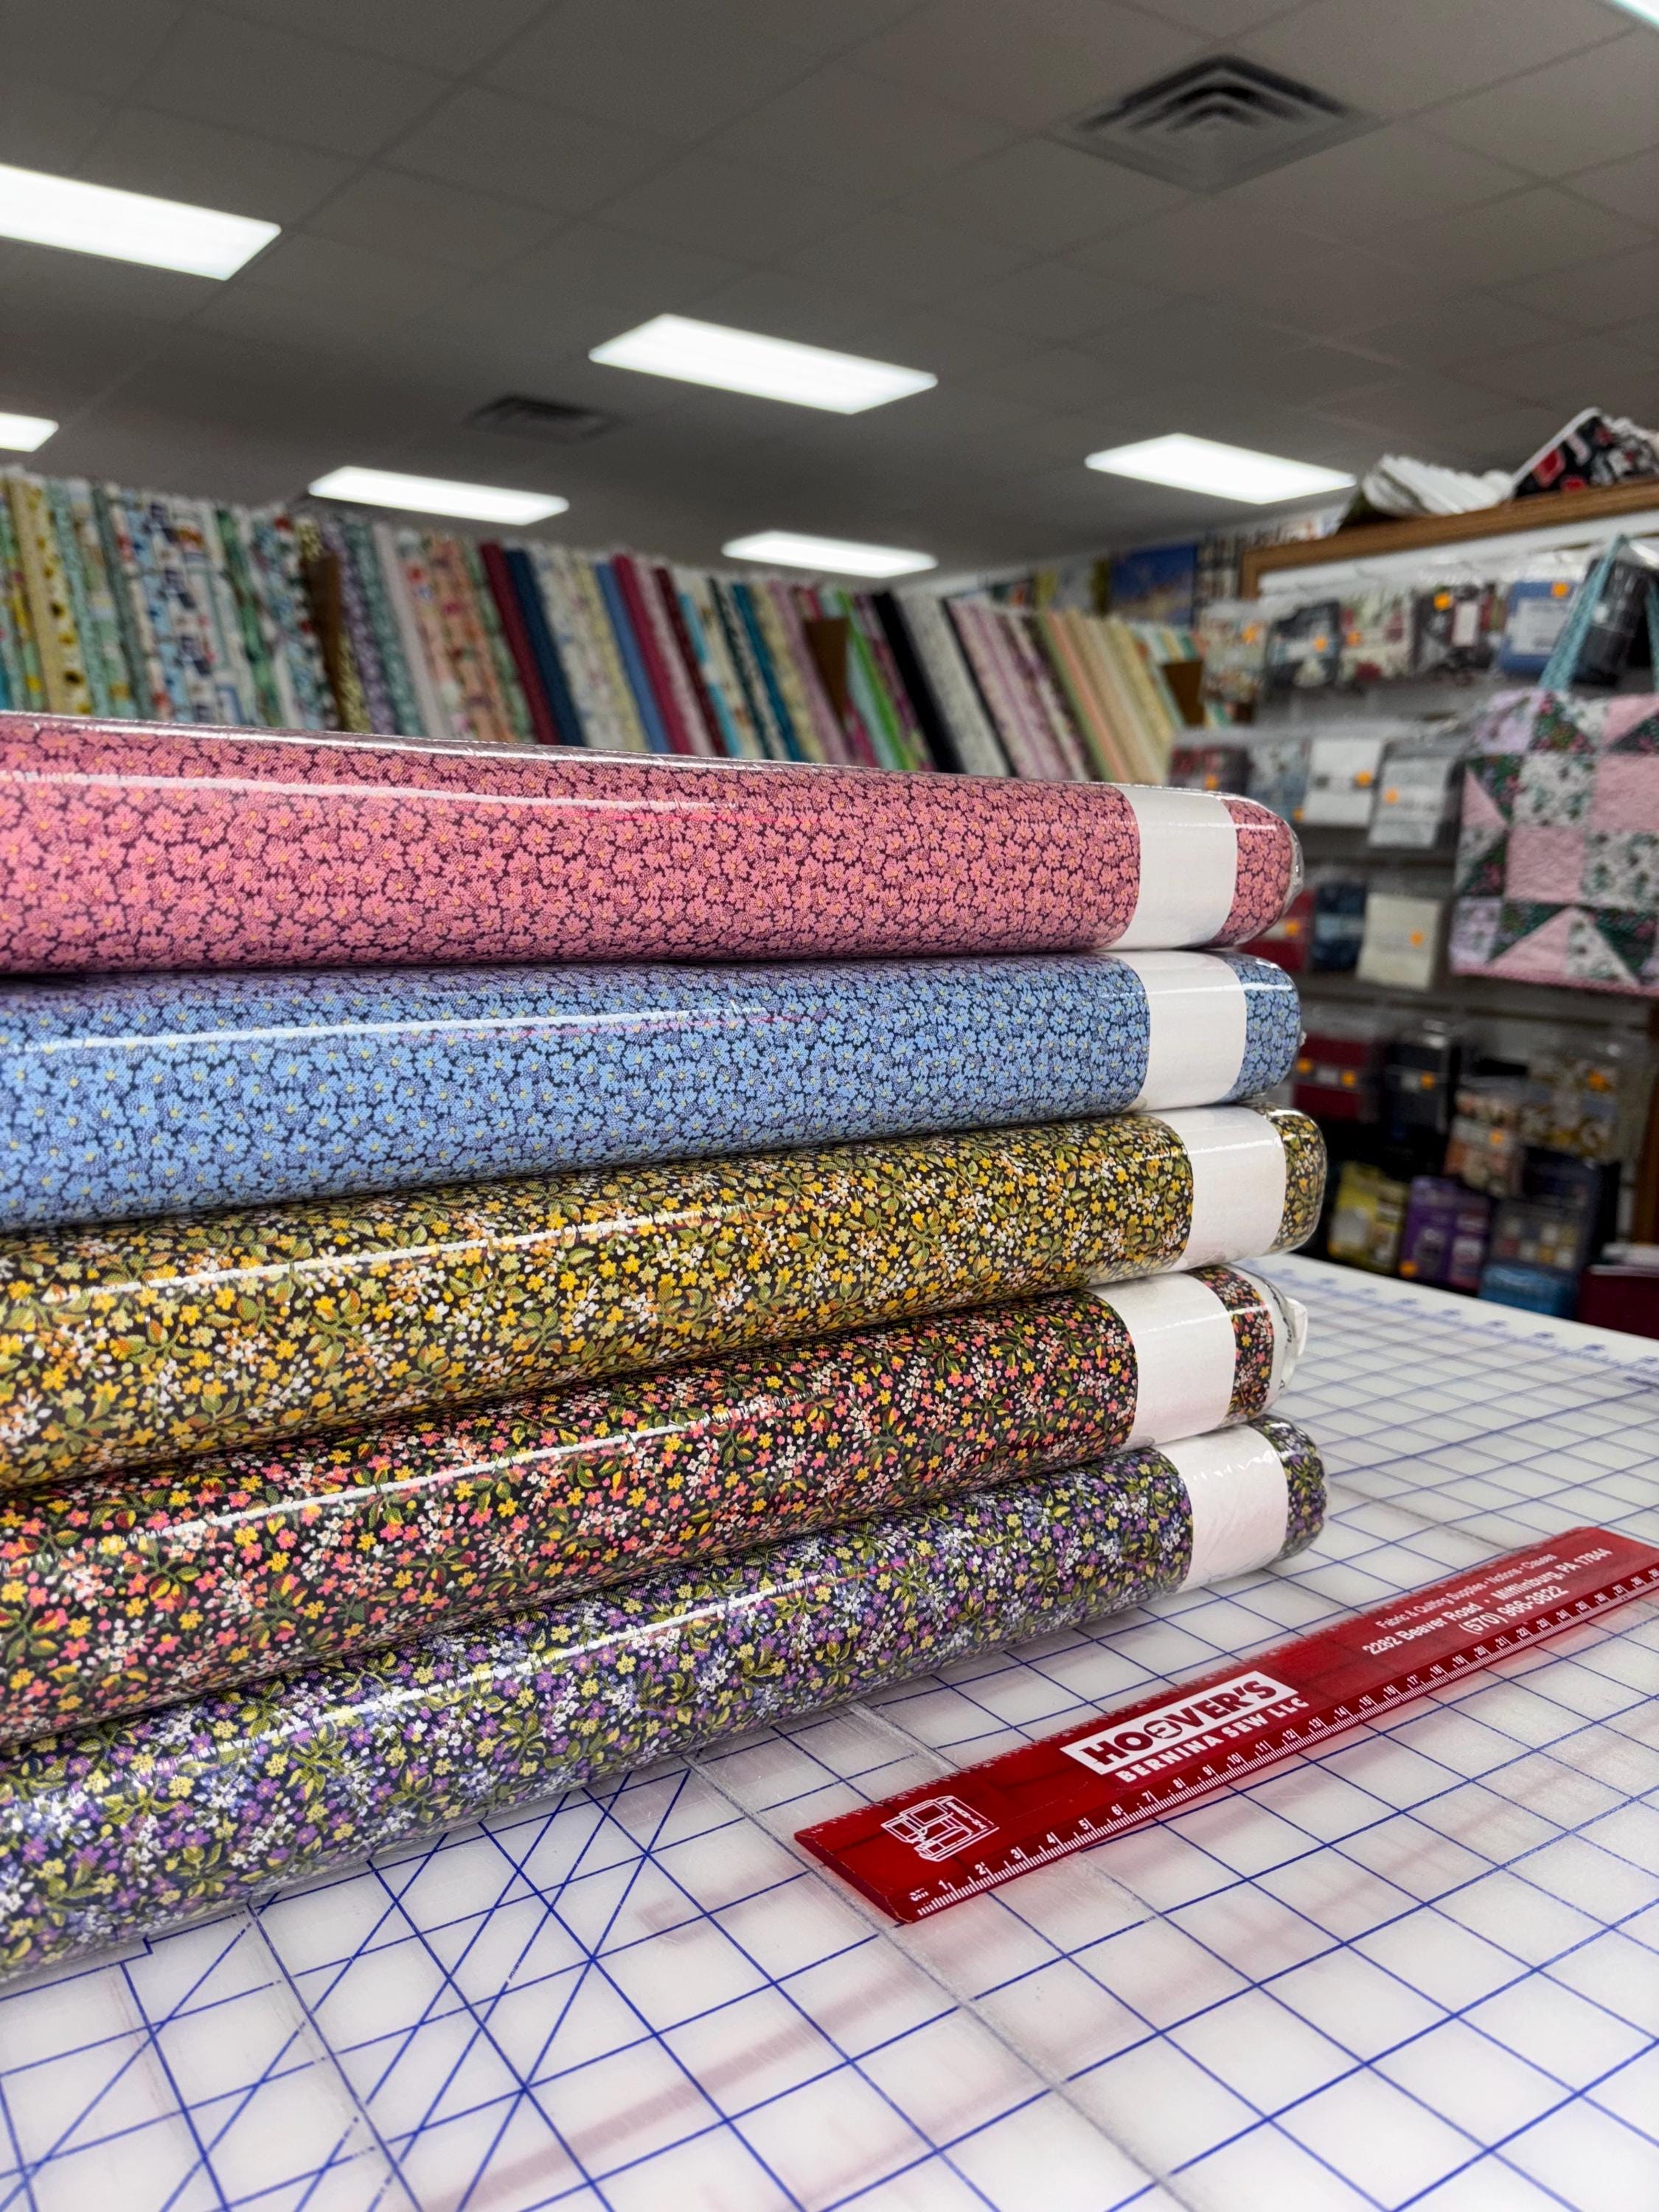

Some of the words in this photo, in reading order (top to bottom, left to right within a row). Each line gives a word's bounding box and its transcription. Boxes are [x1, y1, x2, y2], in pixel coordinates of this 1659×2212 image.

[1362, 1635, 1403, 1655] 2282
[1395, 1618, 1448, 1641] Beaver
[1441, 1602, 1485, 1621] Road
[1554, 1562, 1582, 1573] PA
[1375, 1613, 1410, 1629] Fabric
[1405, 1610, 1419, 1618] &
[1413, 1596, 1454, 1614] Quilting
[1446, 1582, 1487, 1600] Supplies
[1485, 1568, 1522, 1584] Notions
[1458, 1612, 1509, 1635] (570)
[1497, 1585, 1569, 1617] 966-3822
[938, 1879, 948, 1891] 1
[975, 1864, 985, 1875] 2
[1010, 1848, 1021, 1860] 3
[1046, 1832, 1056, 1844] 4
[1078, 1819, 1089, 1830] 5
[1111, 1805, 1121, 1816] 6
[1141, 1792, 1152, 1802] 7
[1172, 1779, 1183, 1789] 8
[1202, 1766, 1212, 1775] 9
[1227, 1754, 1240, 1764] 10
[1256, 1742, 1268, 1753] 11
[1283, 1729, 1296, 1740] 12
[1309, 1718, 1321, 1729] 13
[1335, 1707, 1347, 1717] 14
[1359, 1697, 1371, 1706] 15
[1383, 1686, 1397, 1696] 16
[1407, 1675, 1418, 1685] 17
[1430, 1666, 1442, 1674] 18
[1453, 1655, 1464, 1665] 19
[1474, 1646, 1486, 1656] 20
[1495, 1637, 1506, 1646] 21
[1516, 1627, 1528, 1637] 22
[1115, 1735, 1224, 1783] BERNINA
[1220, 1713, 1268, 1738] SEW
[1267, 1697, 1309, 1718] LLC
